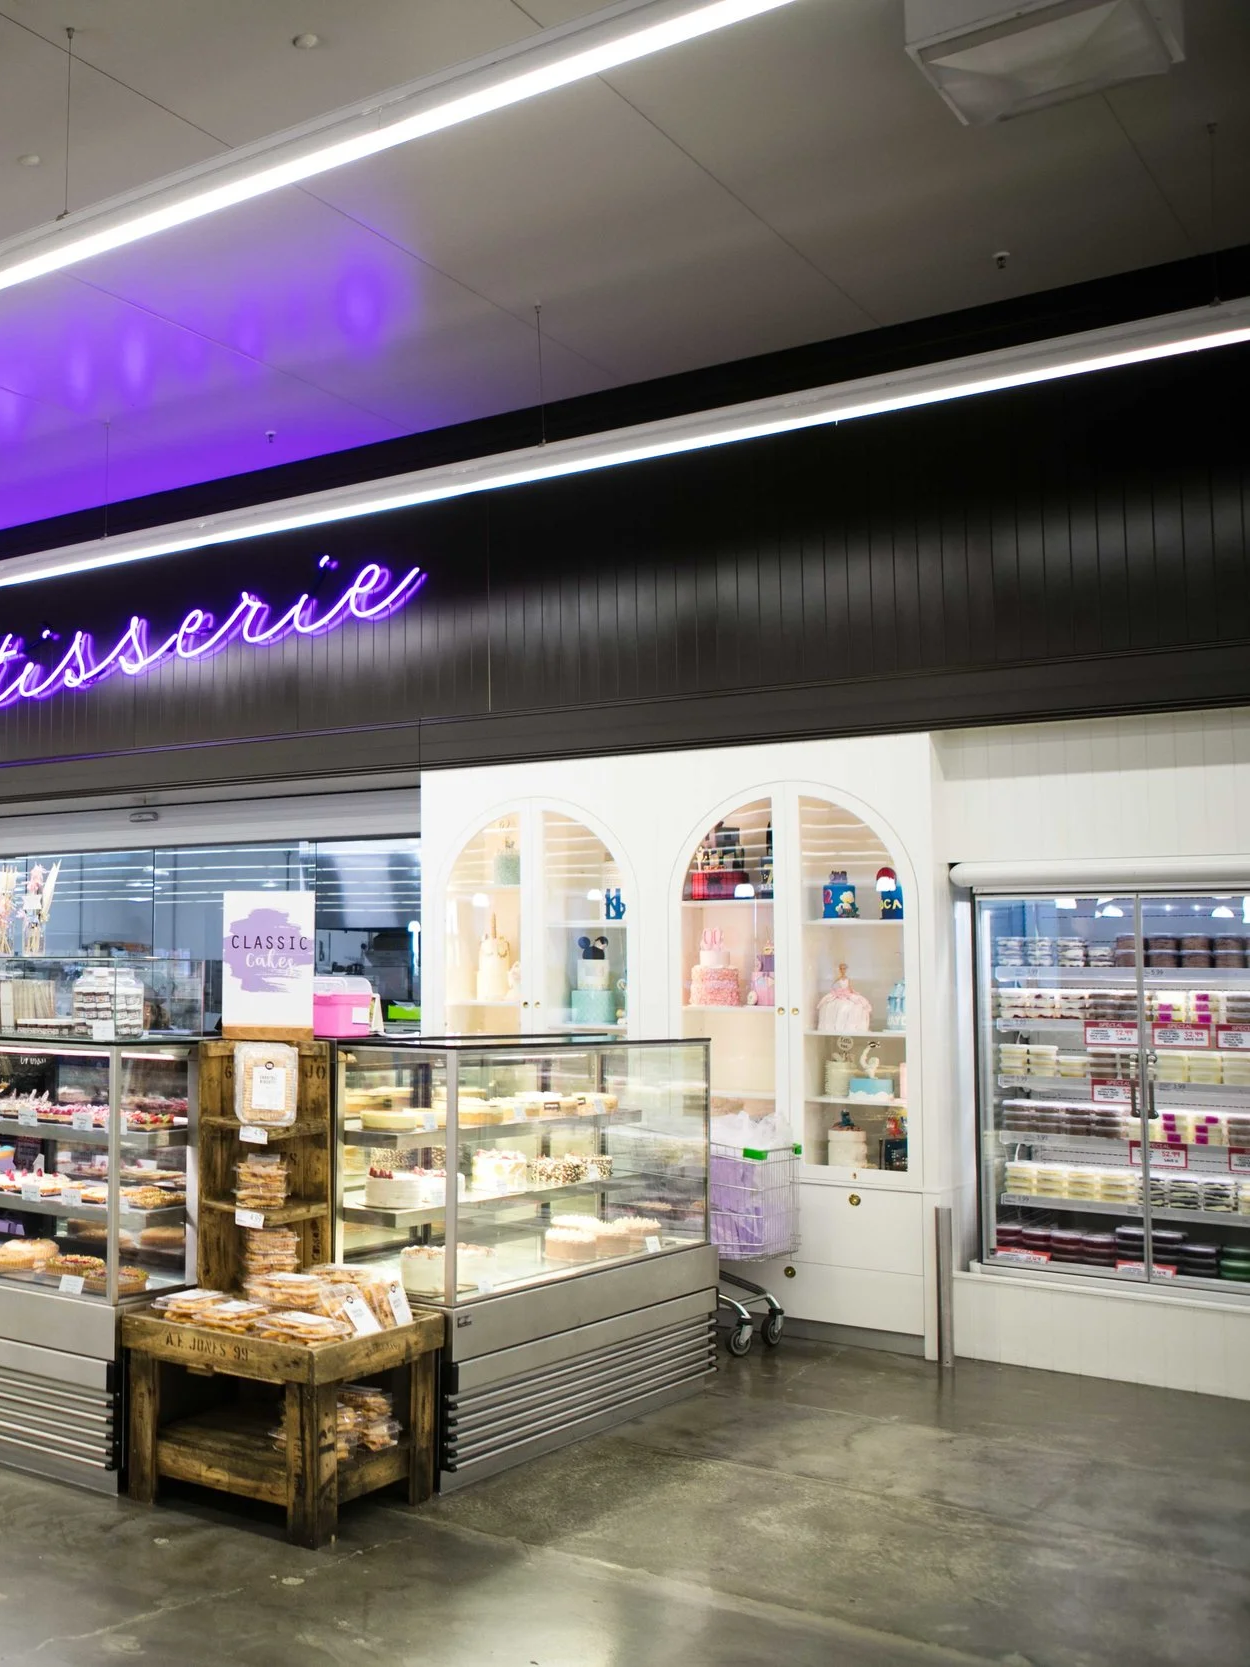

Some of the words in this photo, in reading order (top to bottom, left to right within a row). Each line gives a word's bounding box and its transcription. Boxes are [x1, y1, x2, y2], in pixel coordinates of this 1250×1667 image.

[231, 935, 308, 950] CLASSIC
[245, 949, 294, 971] Cakes
[190, 1337, 226, 1357] JONES
